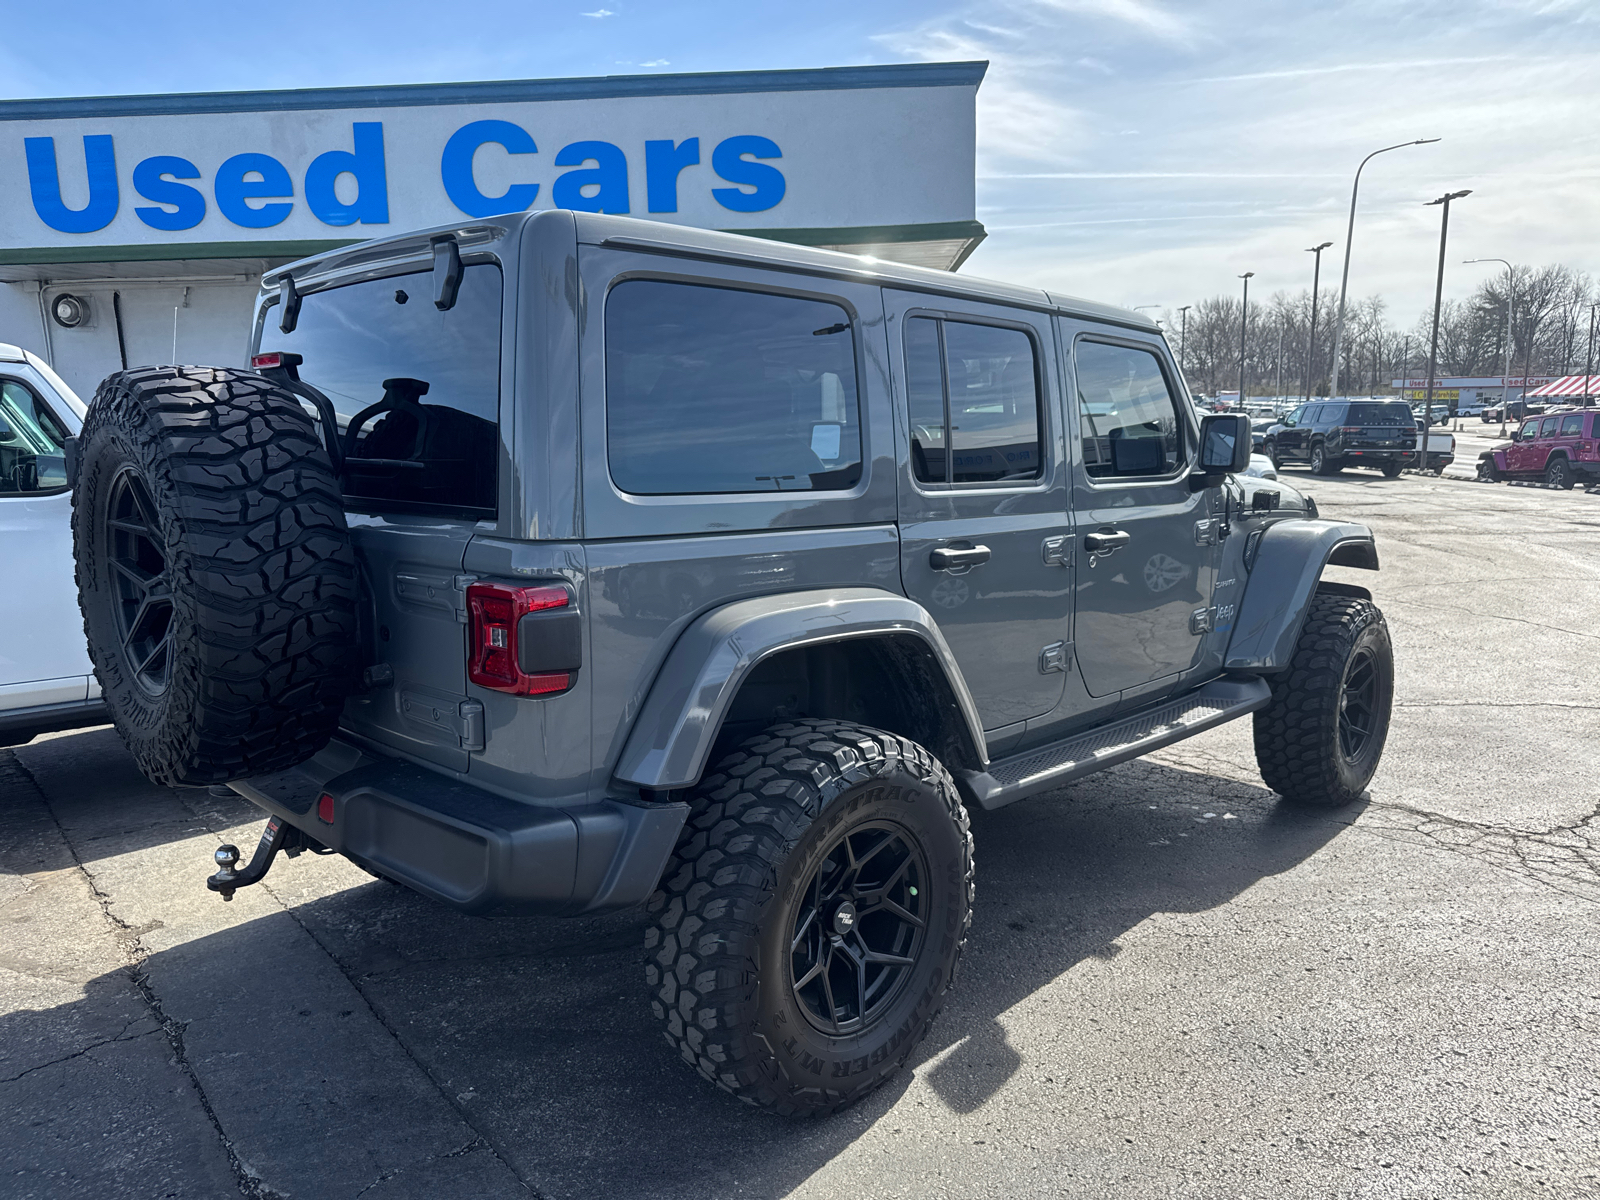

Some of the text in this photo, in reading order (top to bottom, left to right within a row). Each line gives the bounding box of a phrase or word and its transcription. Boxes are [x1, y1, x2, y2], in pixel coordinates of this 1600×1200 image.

[24, 119, 787, 234] Used Cars
[1215, 603, 1234, 621] Jeep
[782, 784, 921, 905] SURETRAC
[938, 857, 963, 960] WIDE
[833, 972, 944, 1079] CLIMBER
